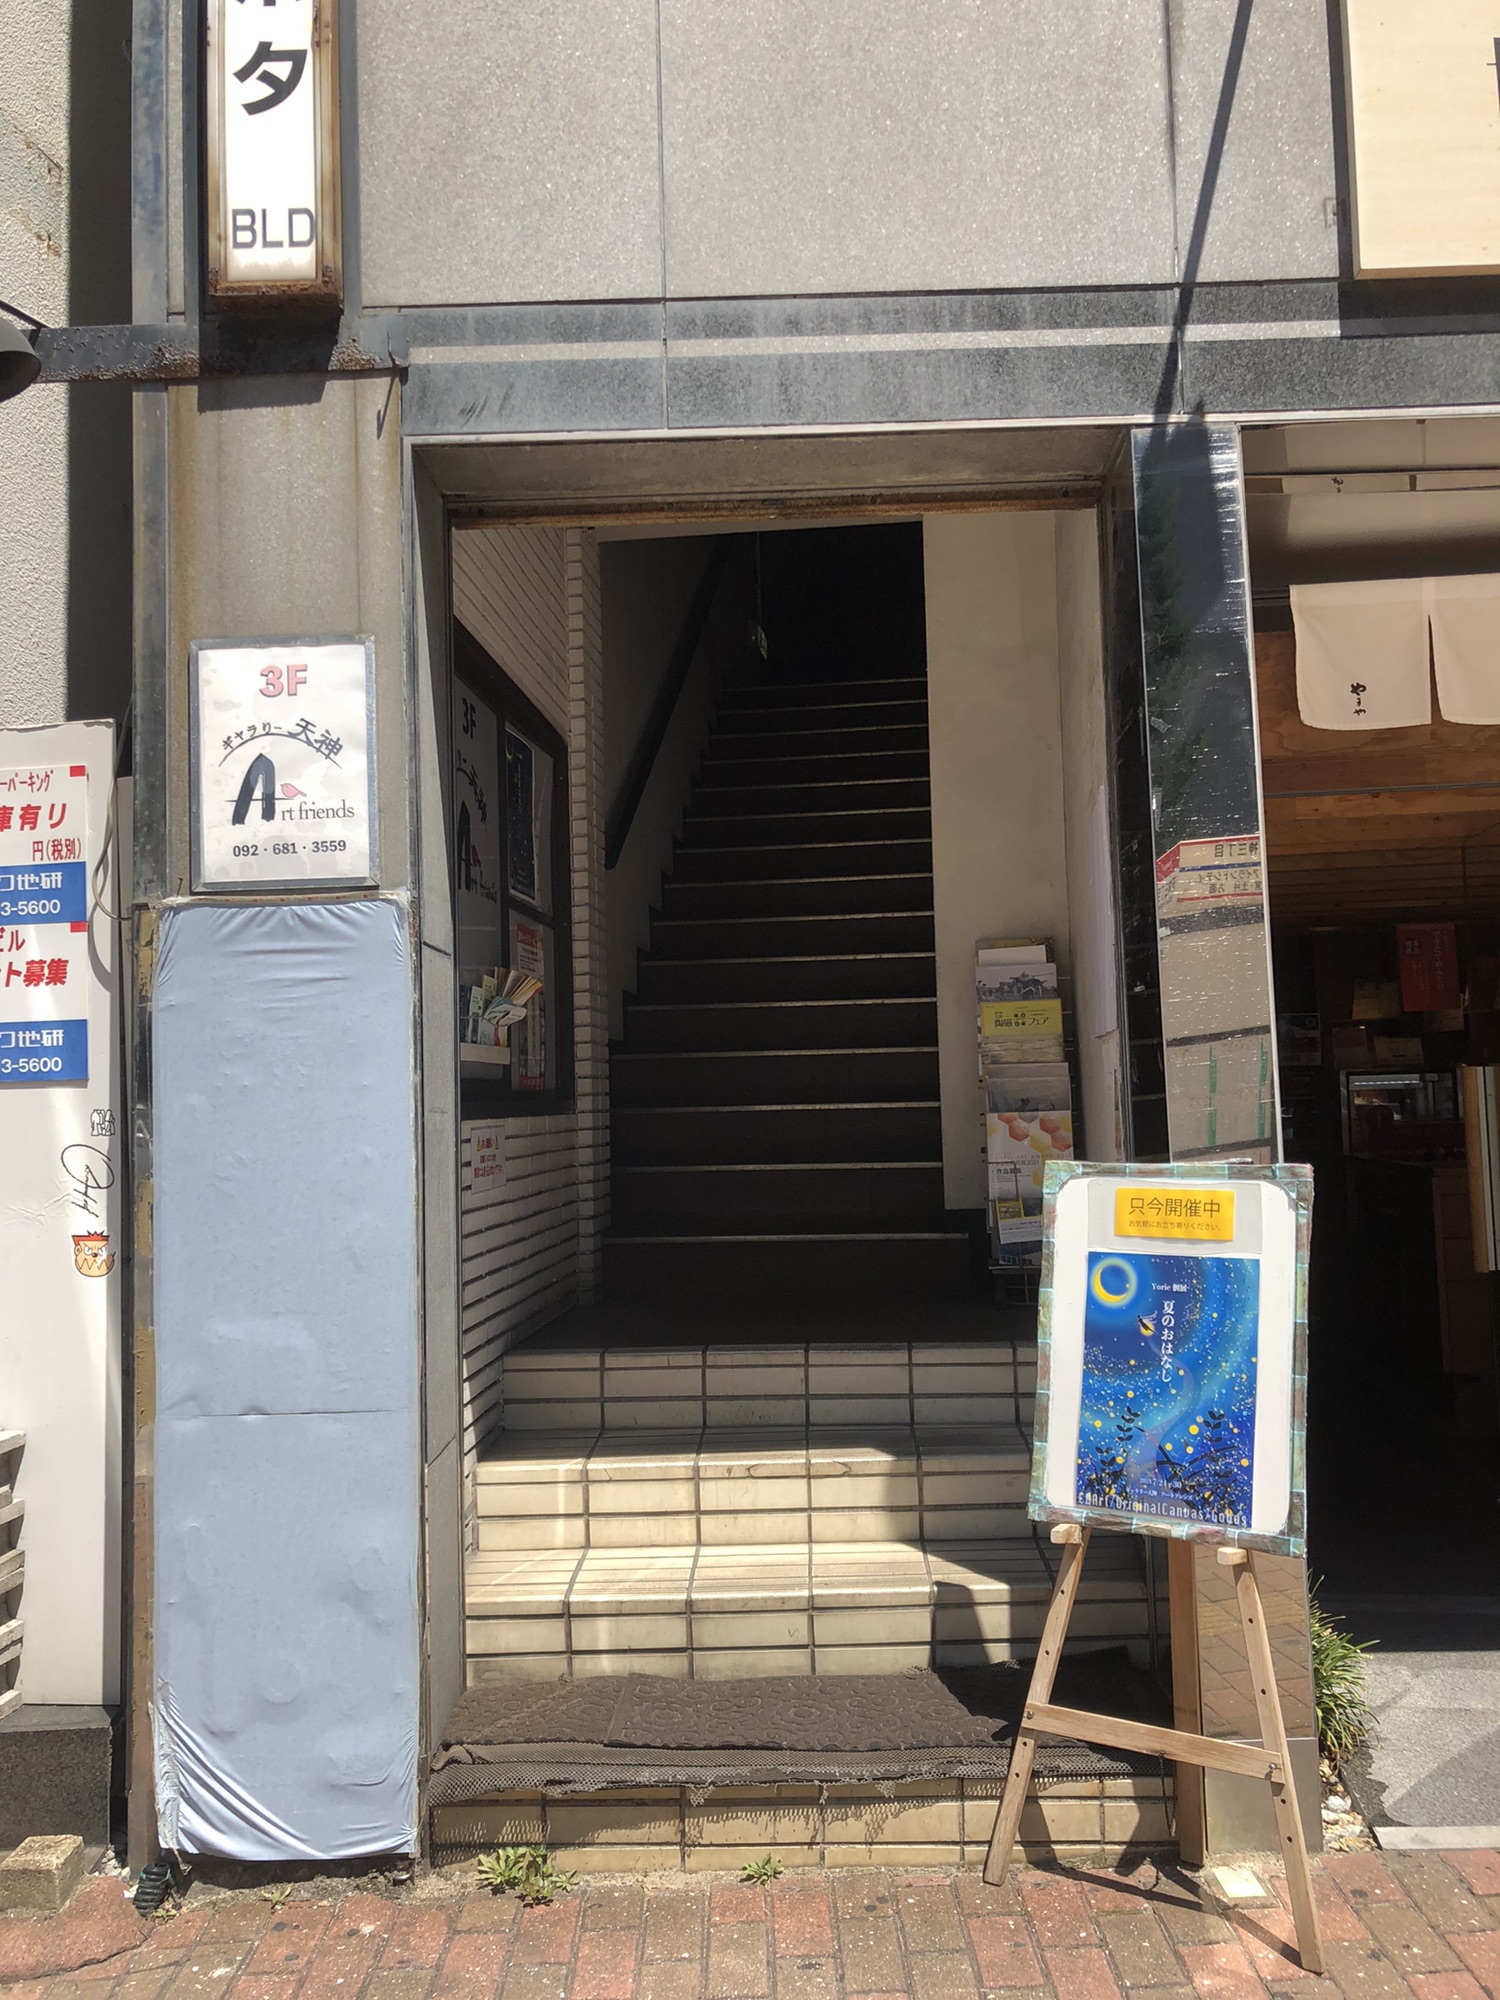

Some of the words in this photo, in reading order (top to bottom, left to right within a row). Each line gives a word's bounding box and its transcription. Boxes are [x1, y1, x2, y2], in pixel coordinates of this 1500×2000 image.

[232, 0, 308, 116] タ
[231, 207, 316, 250] BLD
[259, 663, 308, 698] 3F
[462, 697, 476, 739] 3F
[299, 799, 355, 822] friends
[0, 899, 61, 916] 3-5600
[0, 958, 69, 988] ト募集
[1, 1056, 62, 1074] 3-5600
[1128, 1196, 1221, 1219] 只今開催中
[1128, 1219, 1222, 1232] お気軽にお立ち寄りください。
[1151, 1282, 1172, 1292] Yorie
[1160, 1299, 1176, 1383] 夏のおはなし
